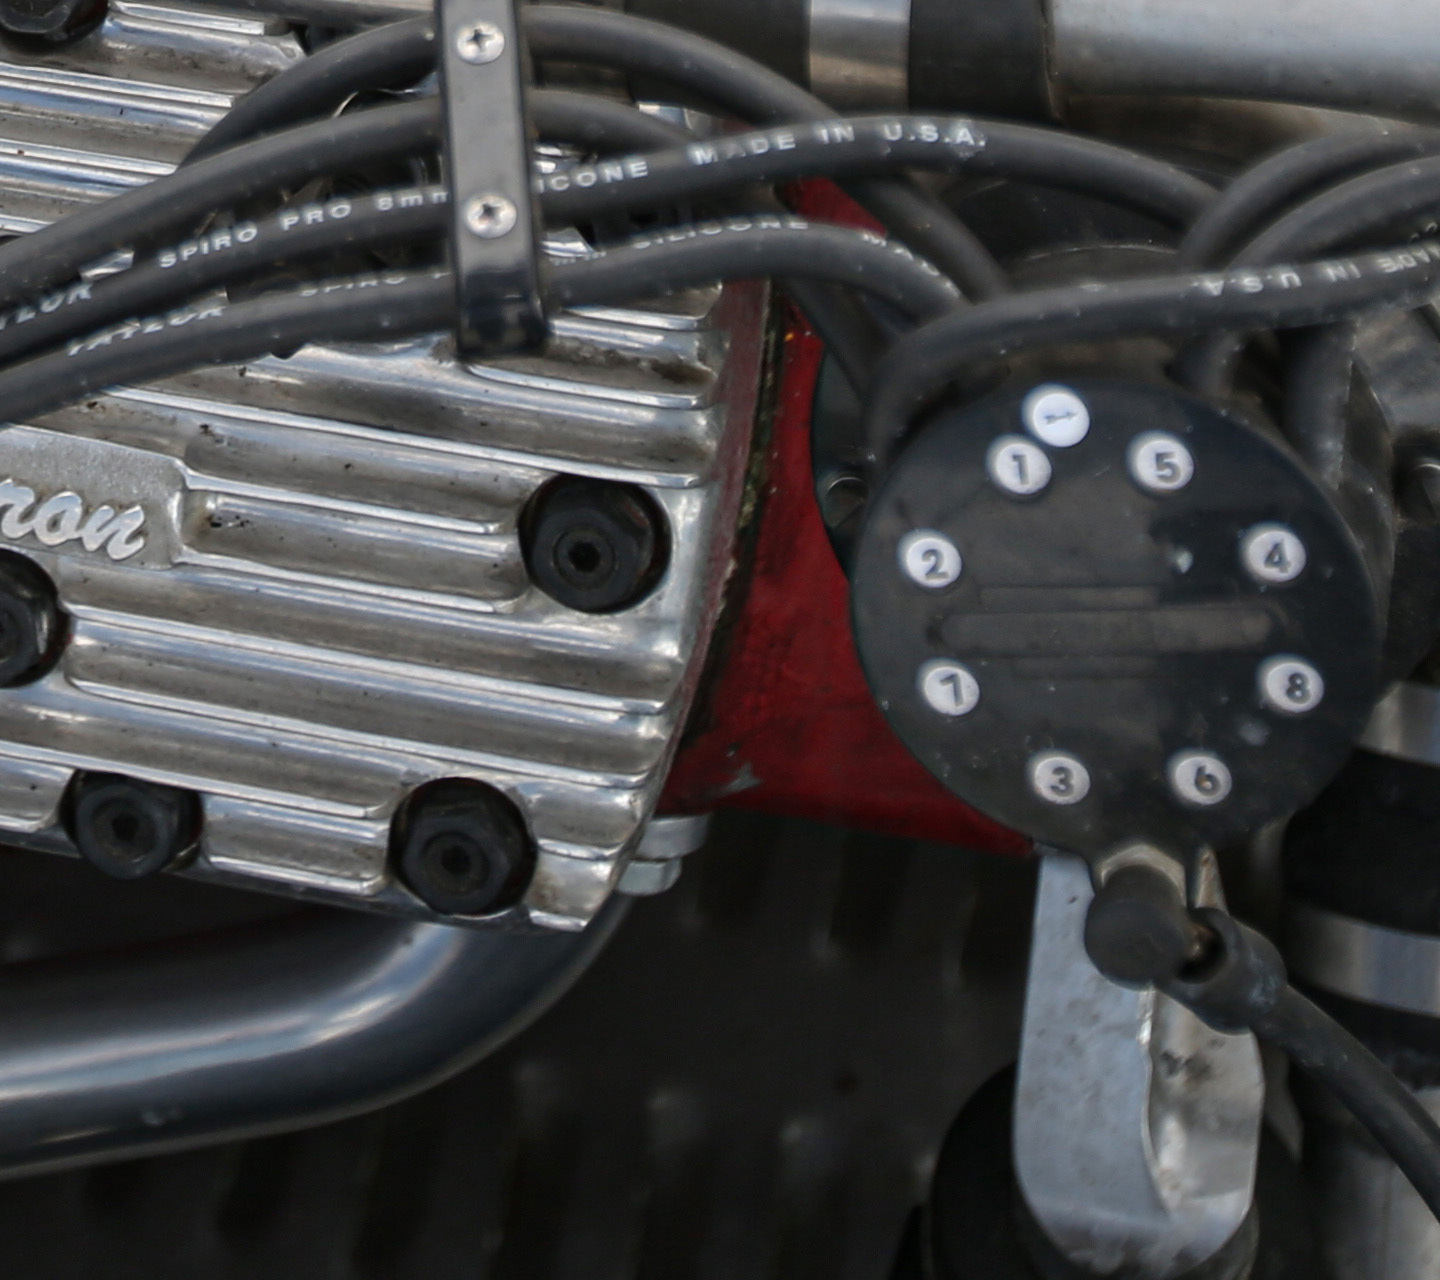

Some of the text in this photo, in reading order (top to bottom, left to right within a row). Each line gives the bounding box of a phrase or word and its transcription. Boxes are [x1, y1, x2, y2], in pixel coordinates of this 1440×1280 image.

[156, 220, 259, 271] SPIRO
[279, 202, 354, 233] PRO
[536, 160, 650, 195] ICONE
[686, 131, 799, 167] MADE
[819, 123, 856, 146] IN
[881, 120, 988, 147] U.S.A.
[1325, 262, 1362, 283] IN
[1010, 452, 1031, 487] 1
[1153, 450, 1183, 485] 5
[920, 547, 950, 581] 2
[1262, 537, 1291, 576] 4
[938, 672, 965, 710] 7
[1285, 670, 1312, 705] 8
[1049, 765, 1077, 799] 3
[1192, 763, 1221, 798] 6
